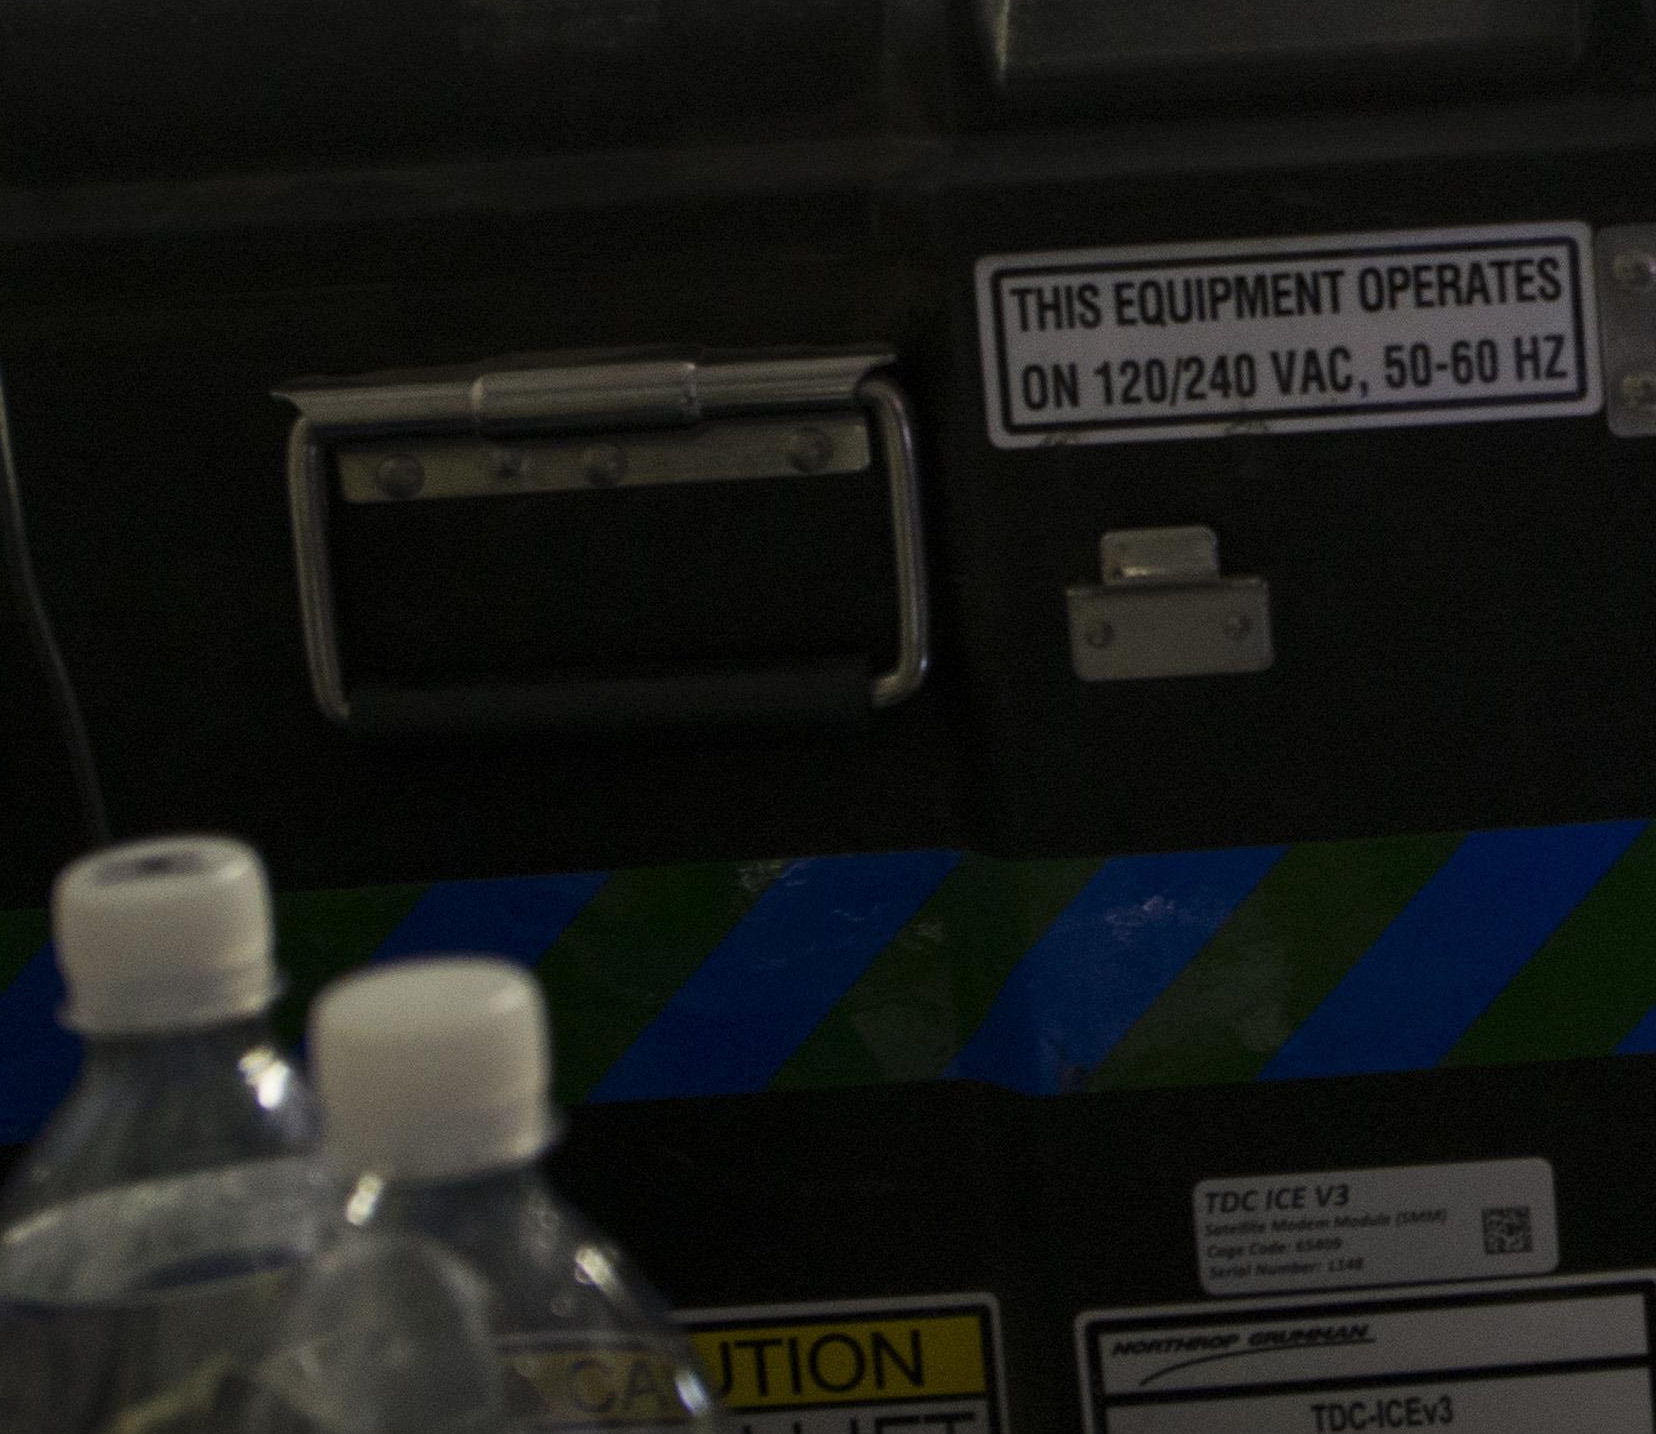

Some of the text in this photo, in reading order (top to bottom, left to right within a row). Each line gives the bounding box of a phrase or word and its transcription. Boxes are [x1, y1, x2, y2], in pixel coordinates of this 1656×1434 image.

[1012, 258, 1563, 333] THIS EQUIPMENT OPERATES
[1021, 334, 1569, 411] ON 120/240 VAC, 50-60 HZ
[1205, 1183, 1351, 1215] TDC ICE V3
[1204, 1216, 1266, 1238] Satellite
[1271, 1215, 1329, 1233] Modem
[1334, 1212, 1390, 1230] Module
[1112, 1324, 1371, 1356] NORTHROP GRUMMAN
[1311, 1396, 1453, 1432] TDC-ICEv3
